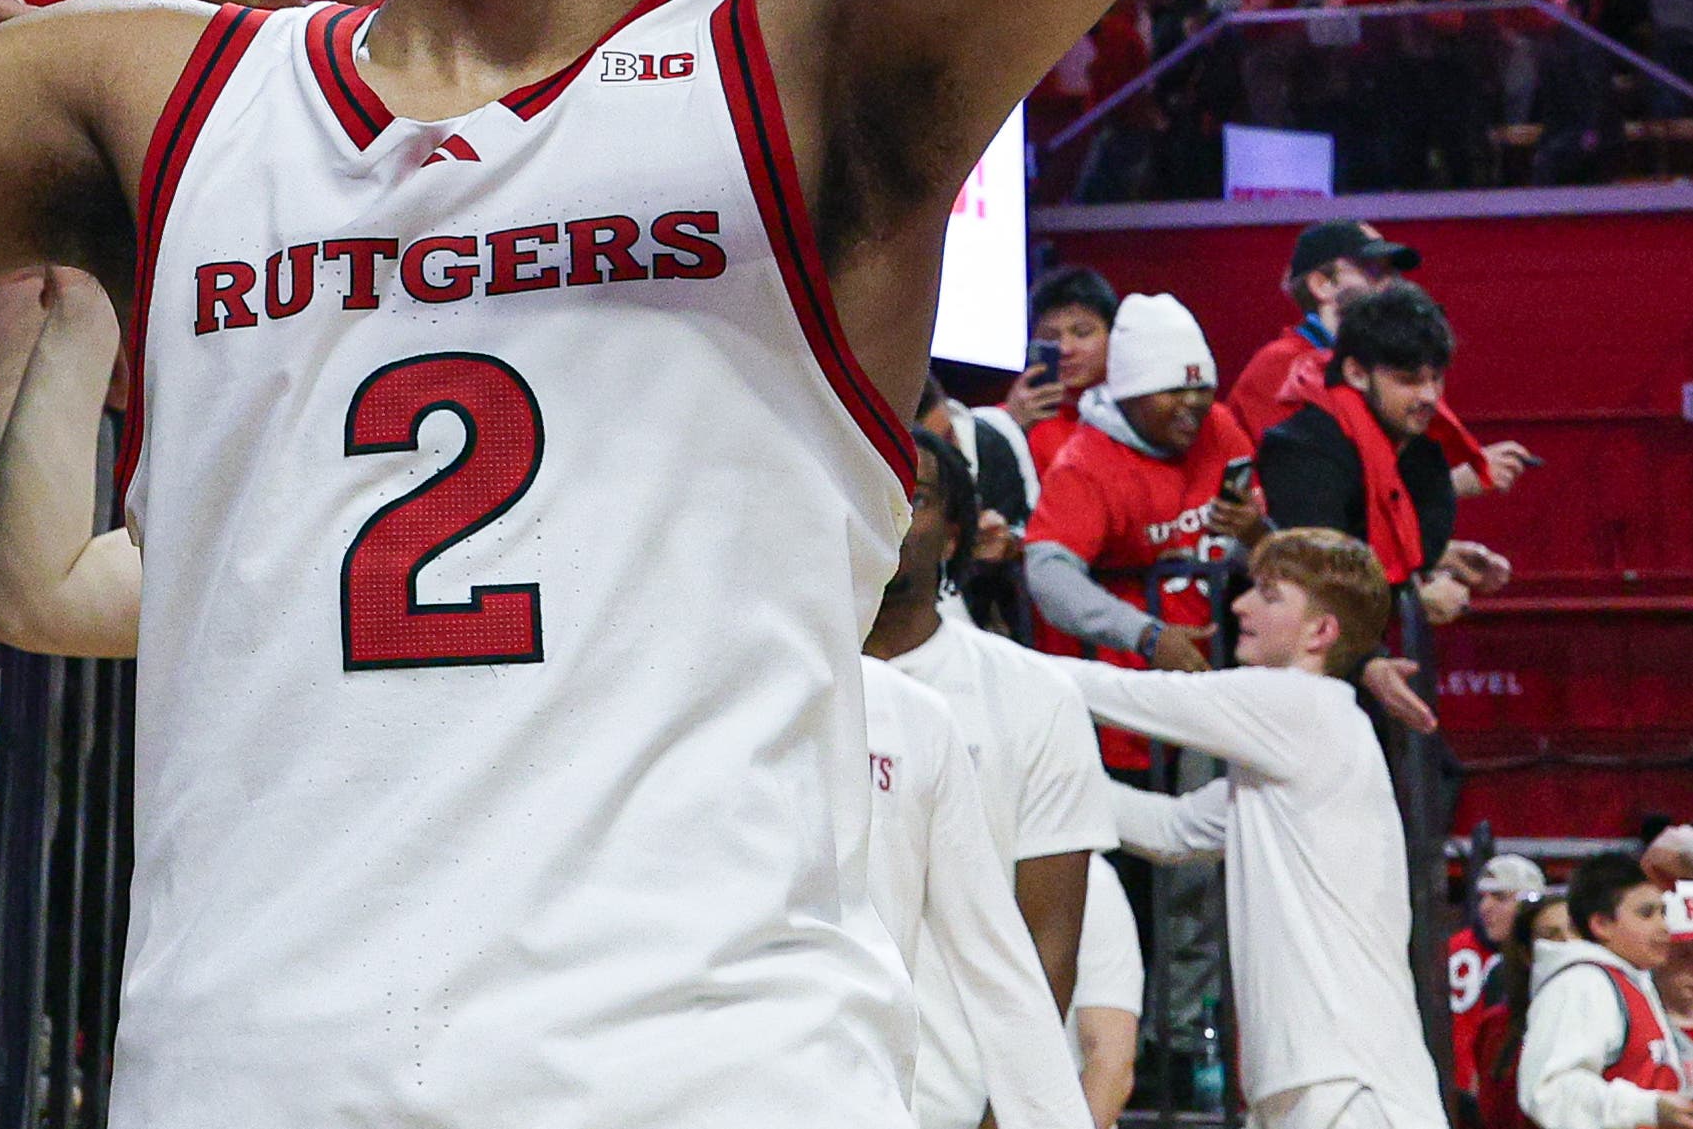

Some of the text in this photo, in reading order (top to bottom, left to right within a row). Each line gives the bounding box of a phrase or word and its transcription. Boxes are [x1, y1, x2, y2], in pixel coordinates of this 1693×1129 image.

[193, 210, 728, 337] RUTGERS
[342, 351, 545, 672] 2
[1436, 669, 1523, 695] EVEL
